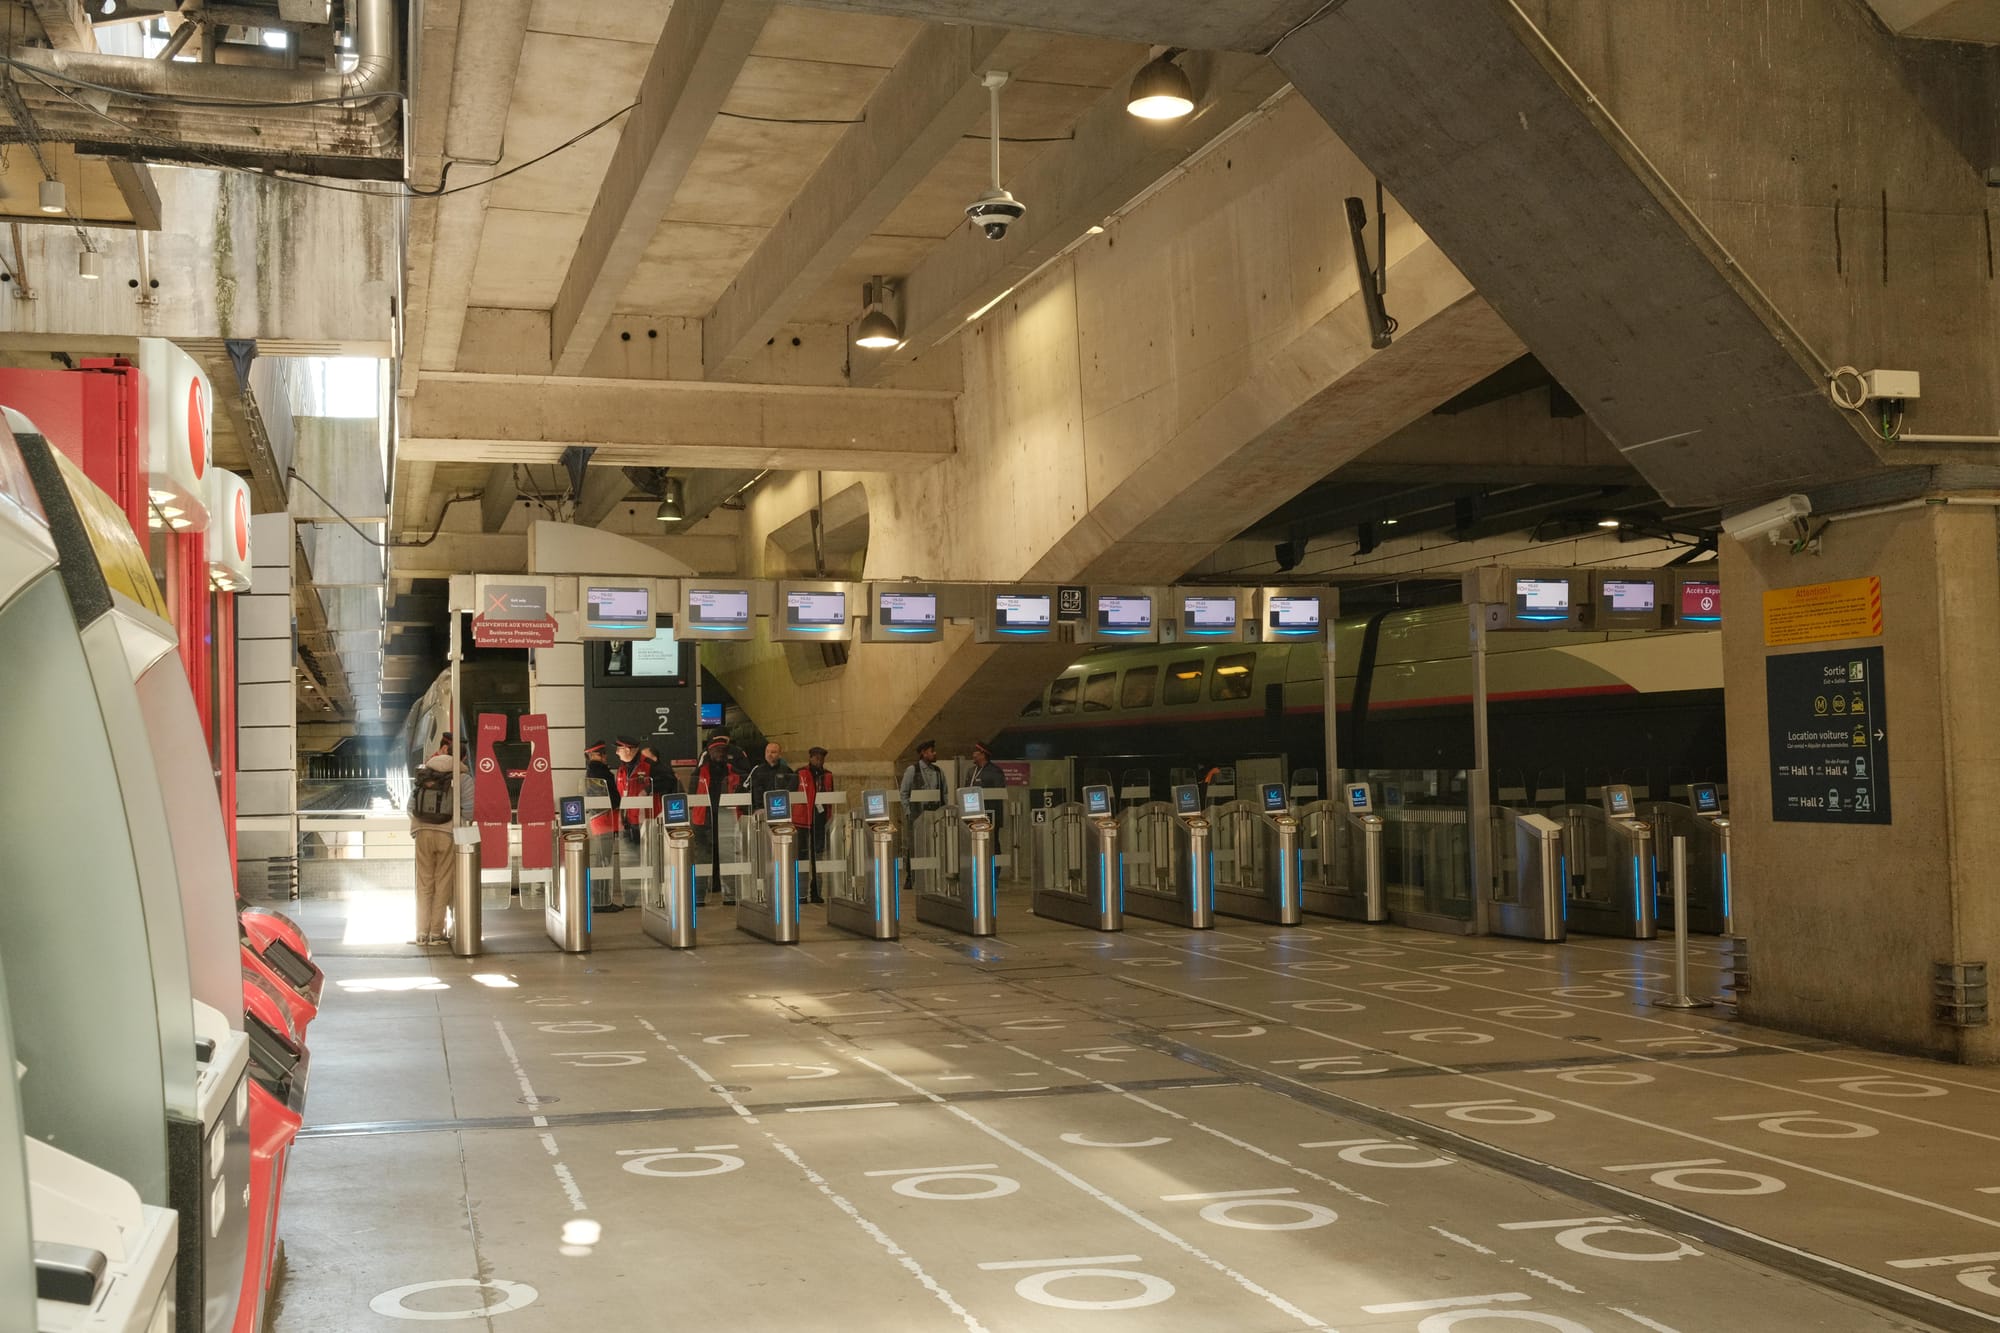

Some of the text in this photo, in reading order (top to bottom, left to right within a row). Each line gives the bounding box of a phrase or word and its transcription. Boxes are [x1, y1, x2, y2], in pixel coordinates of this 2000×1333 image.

[1823, 665, 1846, 676] Sortie
[658, 715, 668, 731] 2
[1788, 730, 1849, 741] Location voitures
[1791, 765, 1808, 776] Hall
[1809, 765, 1814, 776] 1
[1825, 765, 1841, 776] Hall
[1842, 765, 1848, 775] 4
[1800, 796, 1817, 807] Hall
[1818, 797, 1824, 807] 2
[1855, 794, 1870, 809] 24
